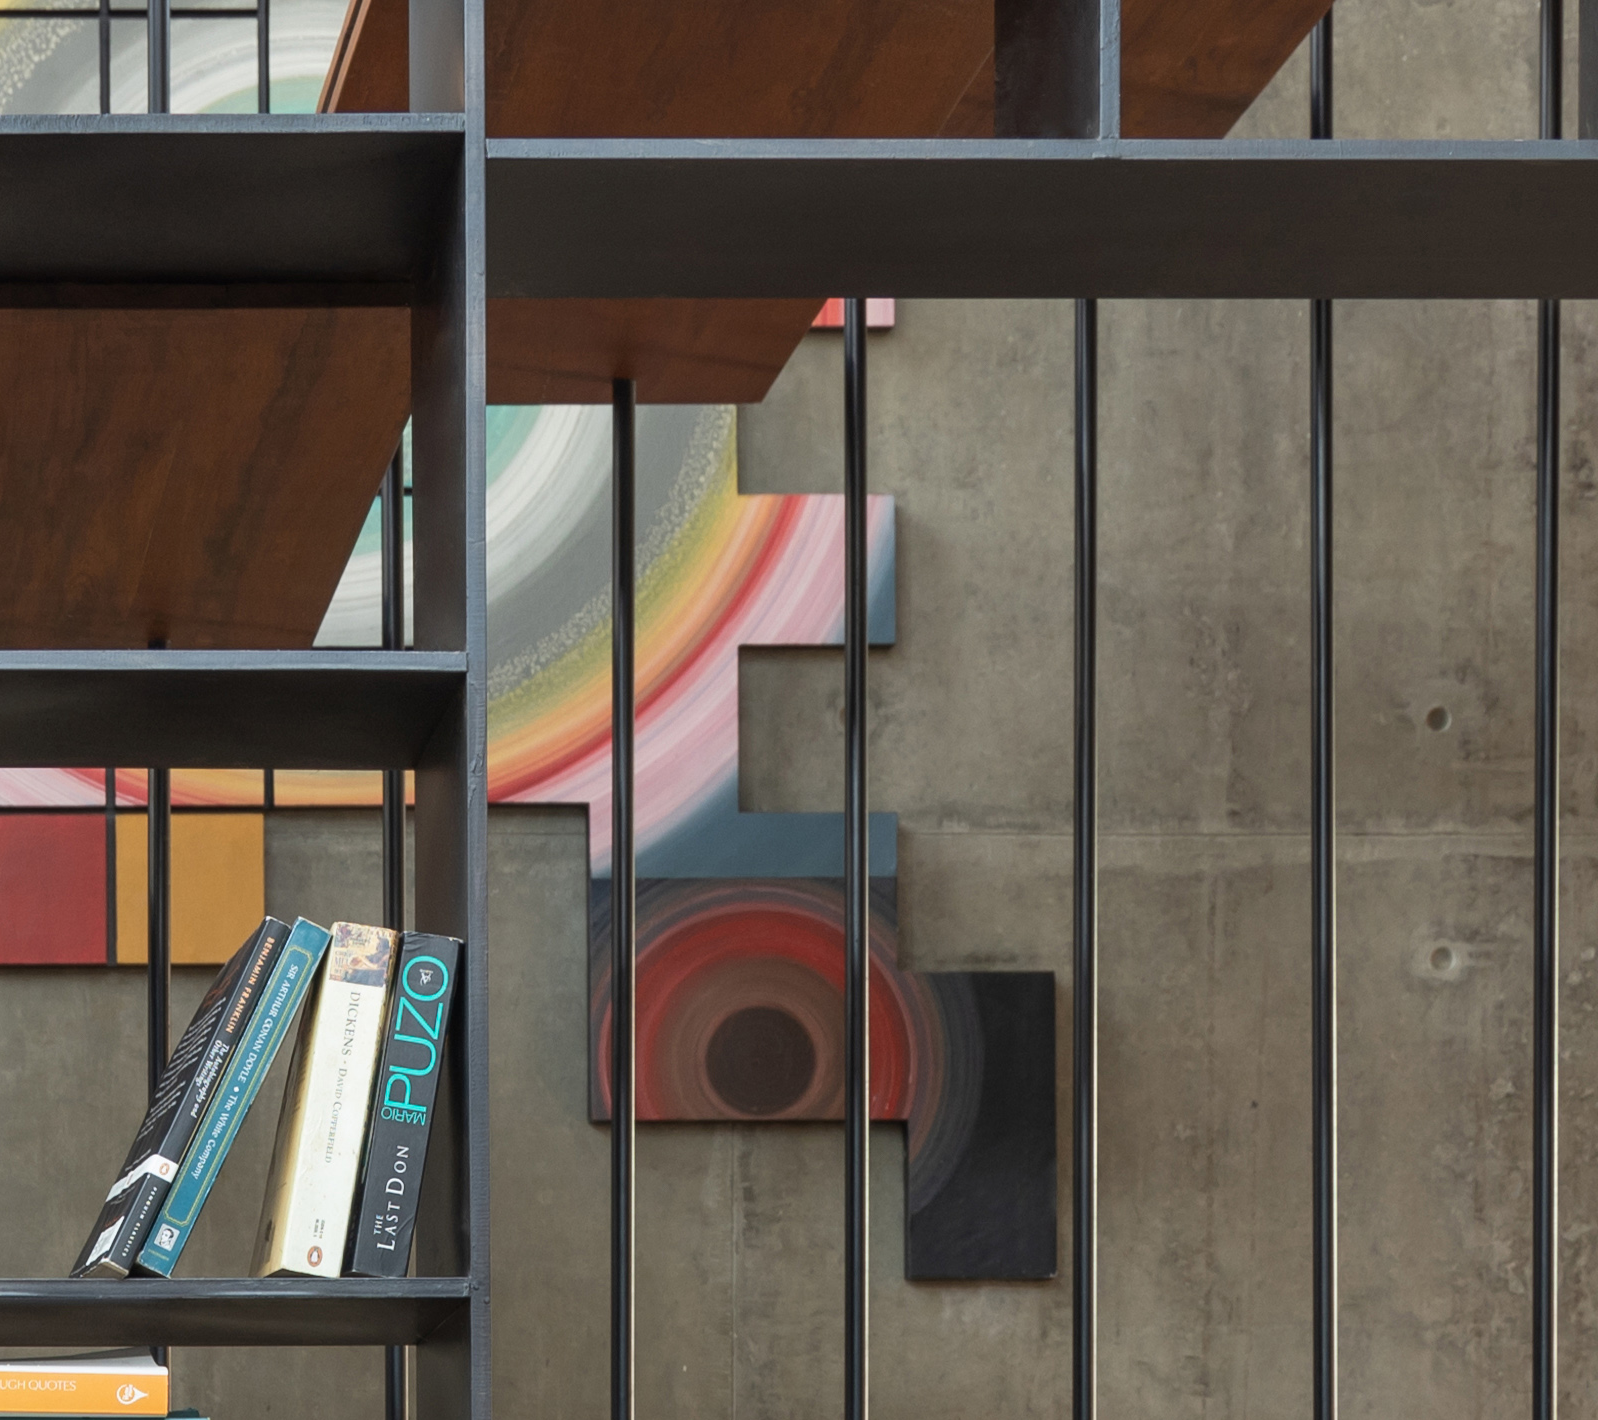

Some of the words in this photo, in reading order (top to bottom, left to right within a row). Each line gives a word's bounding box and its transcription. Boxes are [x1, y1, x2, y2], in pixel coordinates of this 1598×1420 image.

[341, 991, 361, 1056] DICKENS
[385, 955, 450, 1112] PUZO
[380, 1106, 426, 1126] MARIO
[28, 1379, 76, 1391] QUOTES
